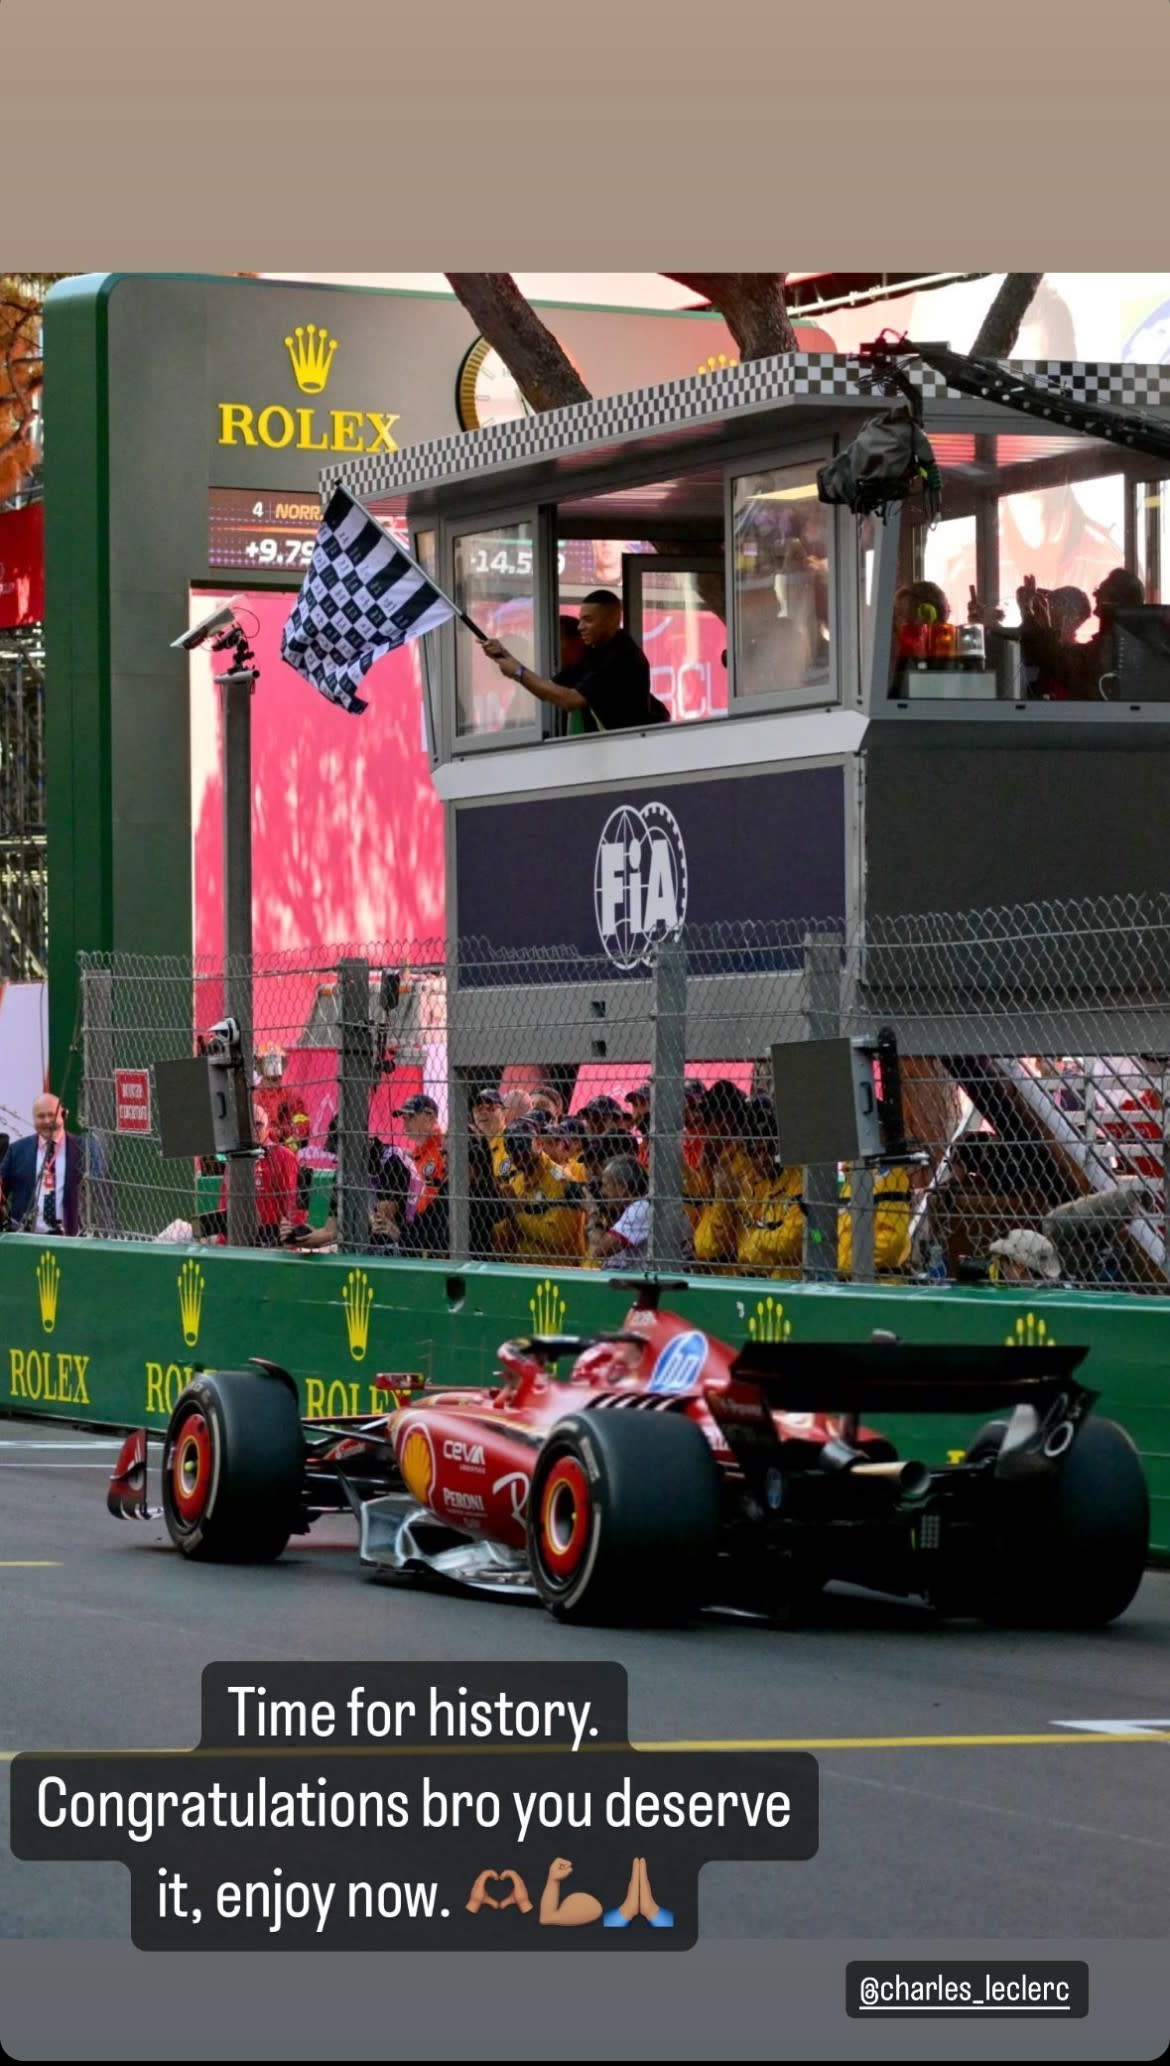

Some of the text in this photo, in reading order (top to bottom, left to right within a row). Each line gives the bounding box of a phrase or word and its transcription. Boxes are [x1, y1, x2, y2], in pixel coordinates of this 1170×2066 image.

[218, 403, 400, 453] ROLEX
[252, 501, 324, 520] 4 NORR
[9, 1348, 91, 1406] ROLEX
[443, 1487, 485, 1511] PERONI
